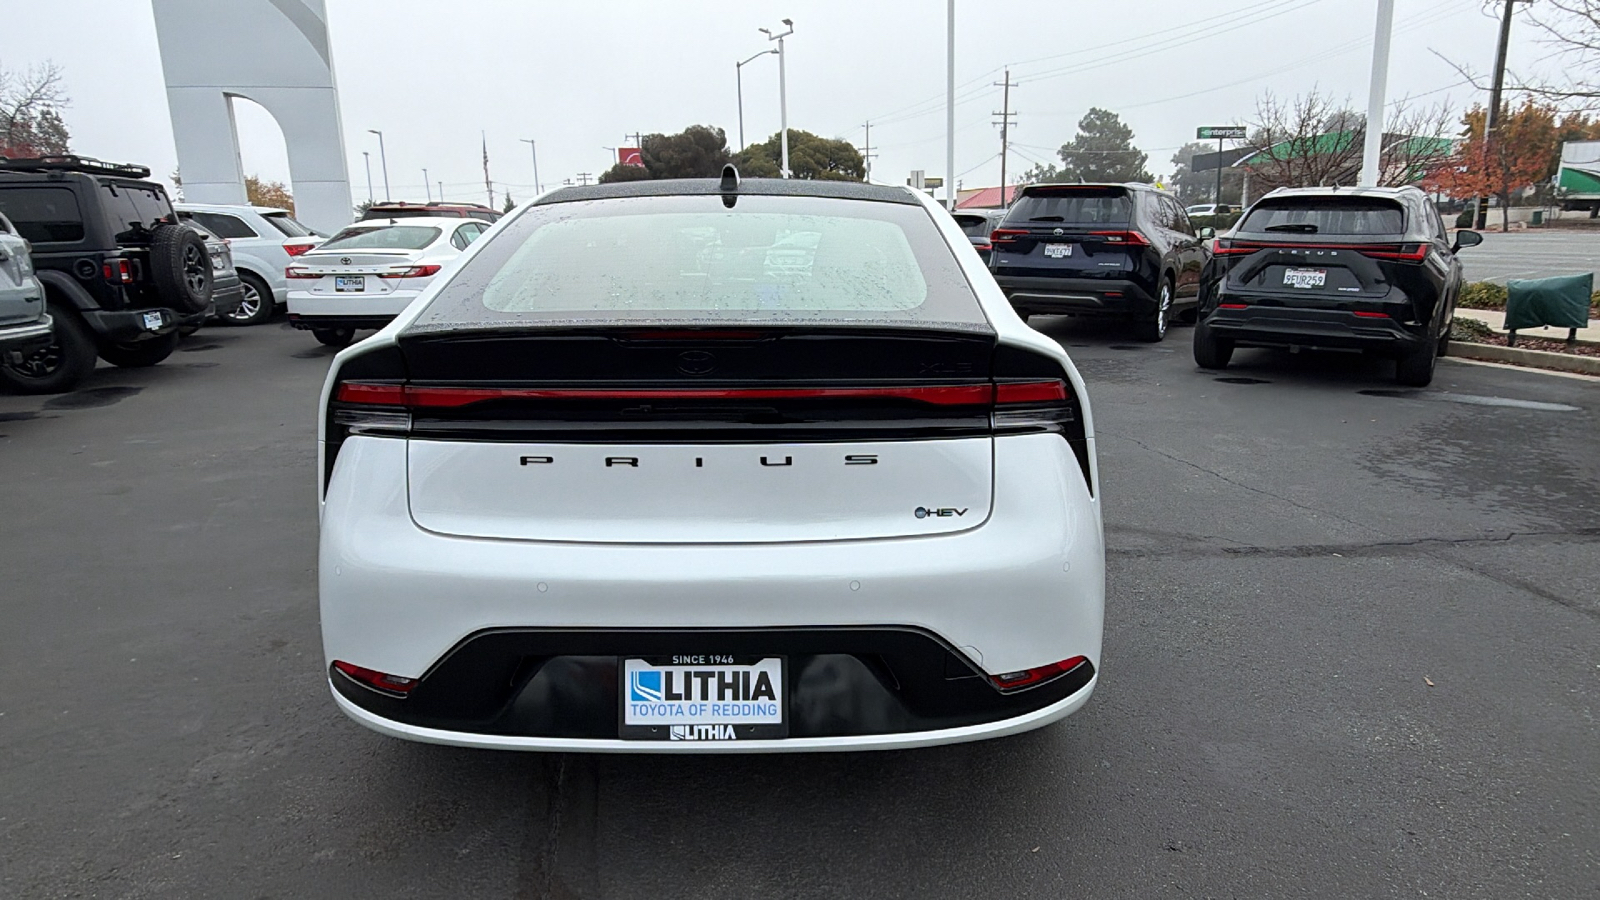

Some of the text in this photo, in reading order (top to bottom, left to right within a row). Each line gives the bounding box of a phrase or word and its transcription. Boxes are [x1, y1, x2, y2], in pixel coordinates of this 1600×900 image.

[519, 454, 879, 468] PRIUS
[672, 655, 734, 664] SINCE 1946
[664, 670, 777, 701] LITHIA
[630, 704, 778, 717] TOYOTA OF REDDING
[684, 724, 737, 740] LITHIA
